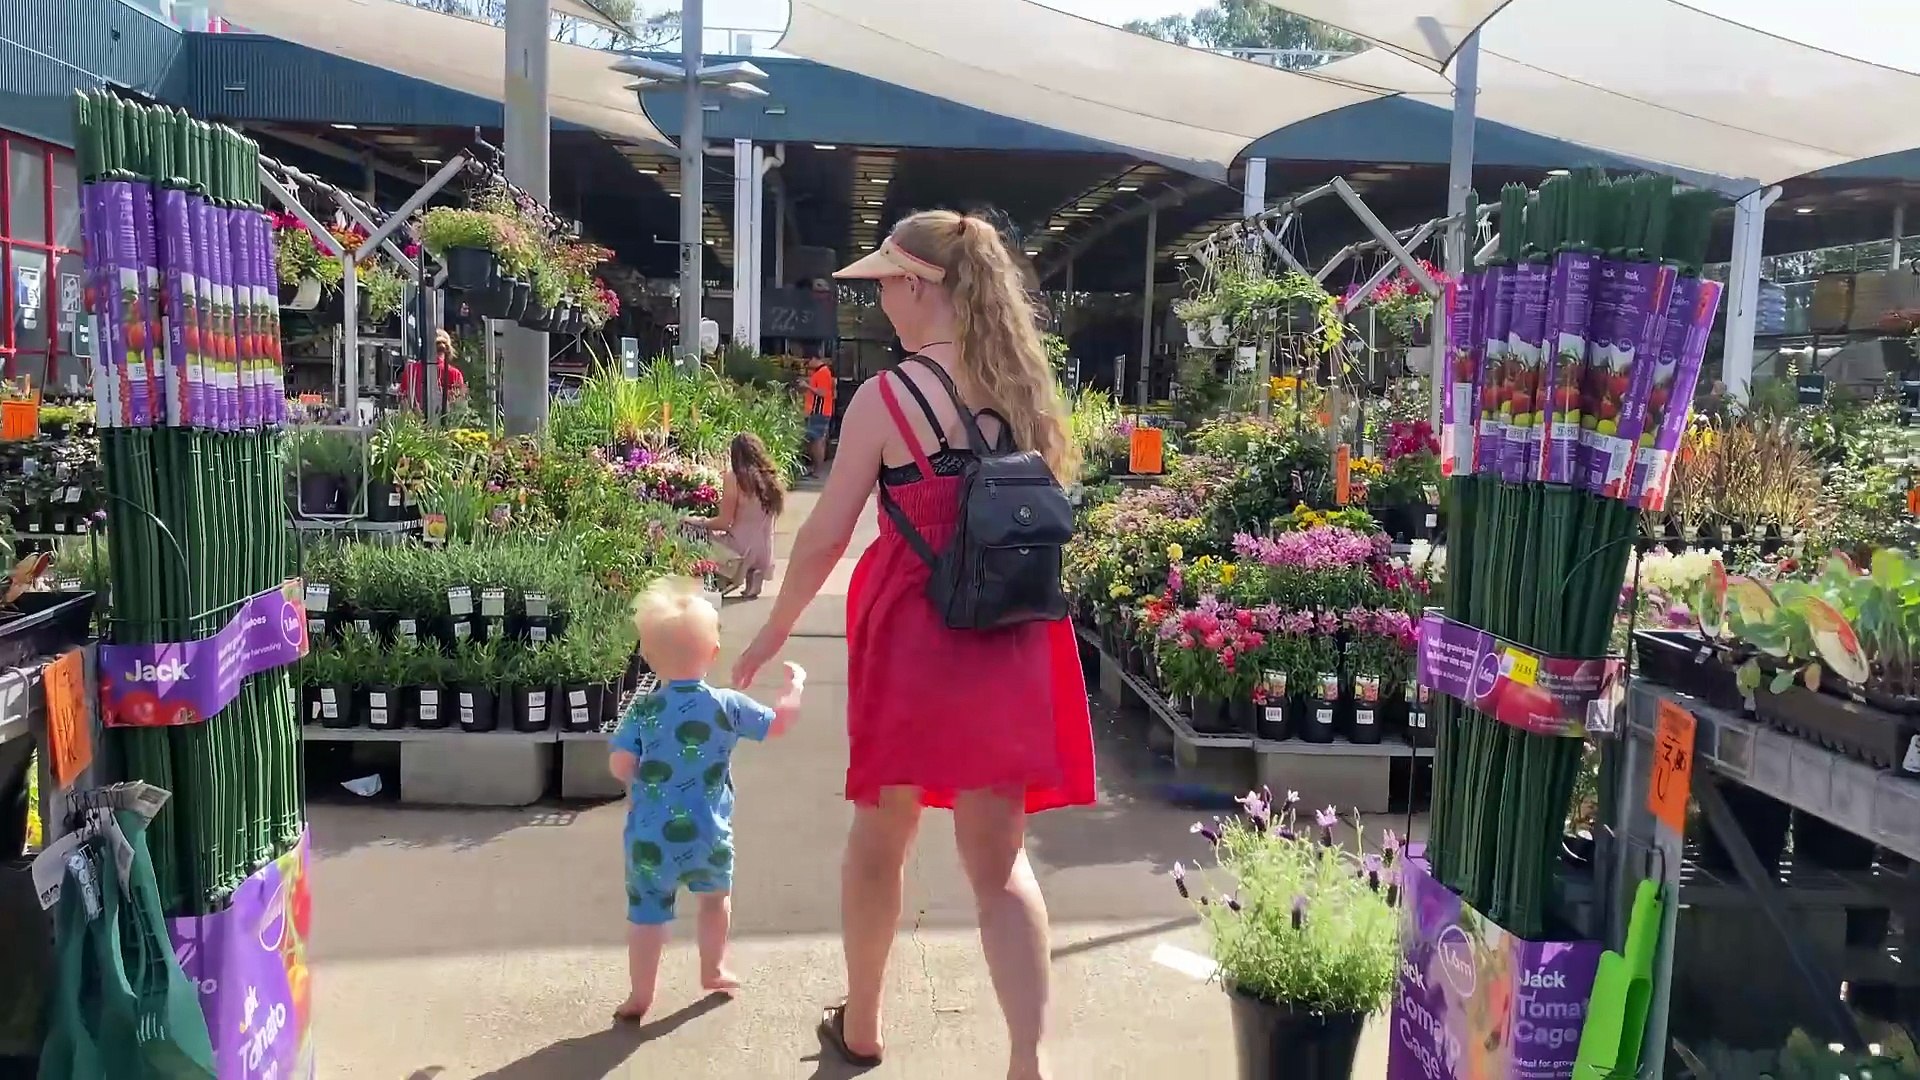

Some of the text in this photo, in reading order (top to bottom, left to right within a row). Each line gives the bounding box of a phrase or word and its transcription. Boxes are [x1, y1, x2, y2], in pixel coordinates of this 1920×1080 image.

[124, 657, 190, 683] Jack
[1520, 968, 1567, 989] Jack
[1515, 1020, 1579, 1049] Cage
[1400, 1017, 1441, 1080] Cage
[1539, 1059, 1553, 1068] for
